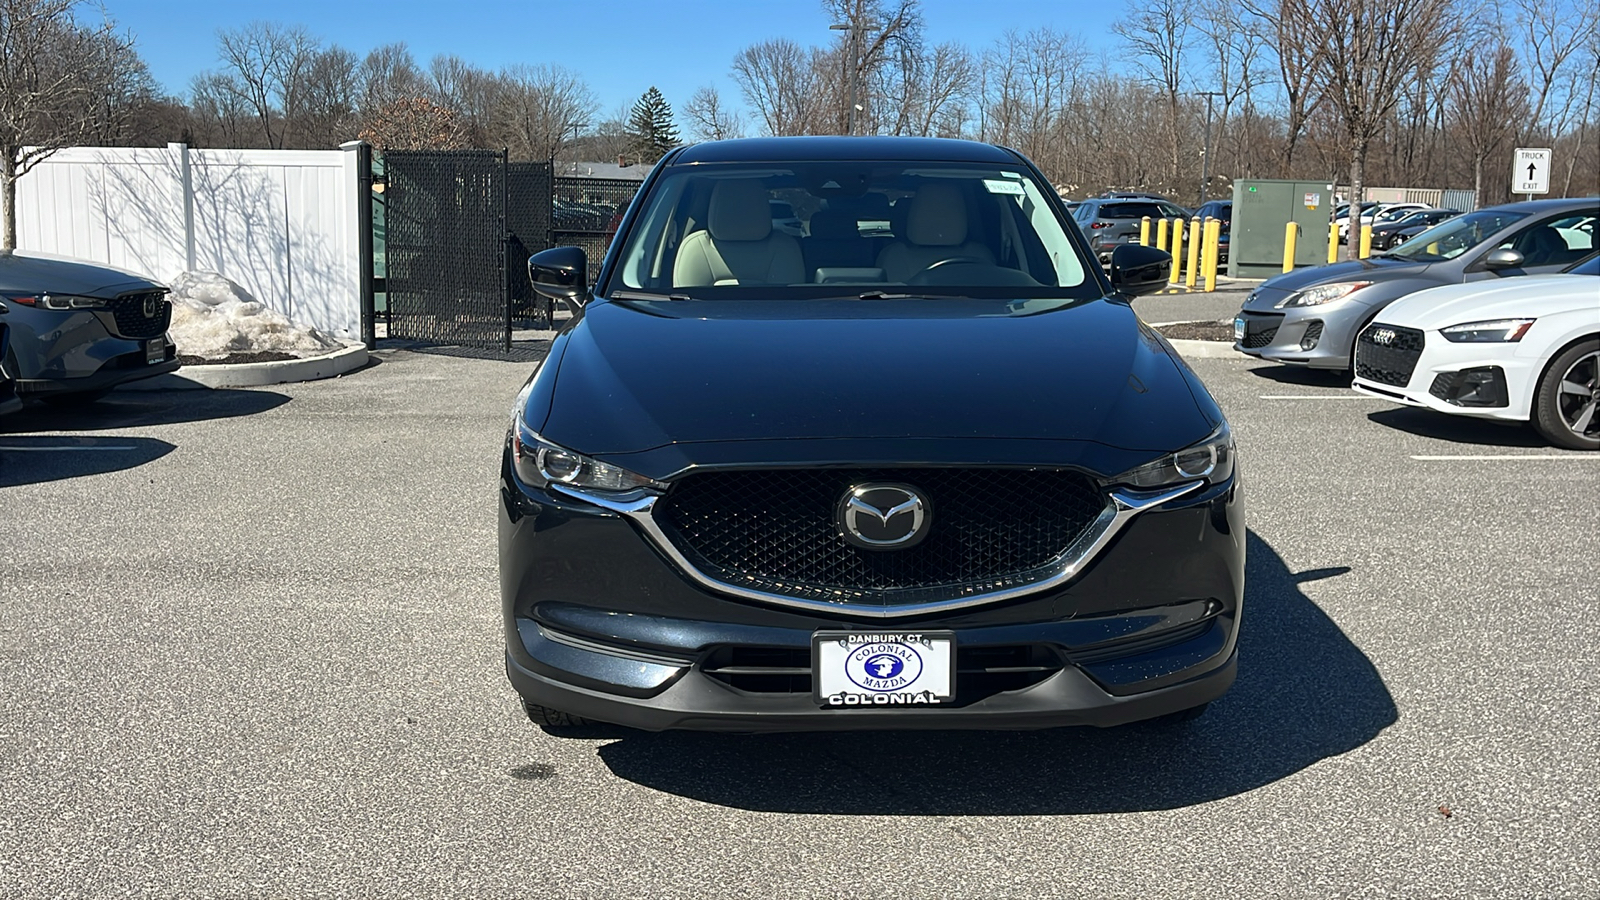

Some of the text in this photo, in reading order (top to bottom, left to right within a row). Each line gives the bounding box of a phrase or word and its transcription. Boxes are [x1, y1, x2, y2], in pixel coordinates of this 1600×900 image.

[849, 634, 922, 643] DANBURY, CT
[855, 645, 913, 662] COLONIAL
[863, 676, 907, 688] MAZDA
[828, 693, 941, 705] COLONIAL
